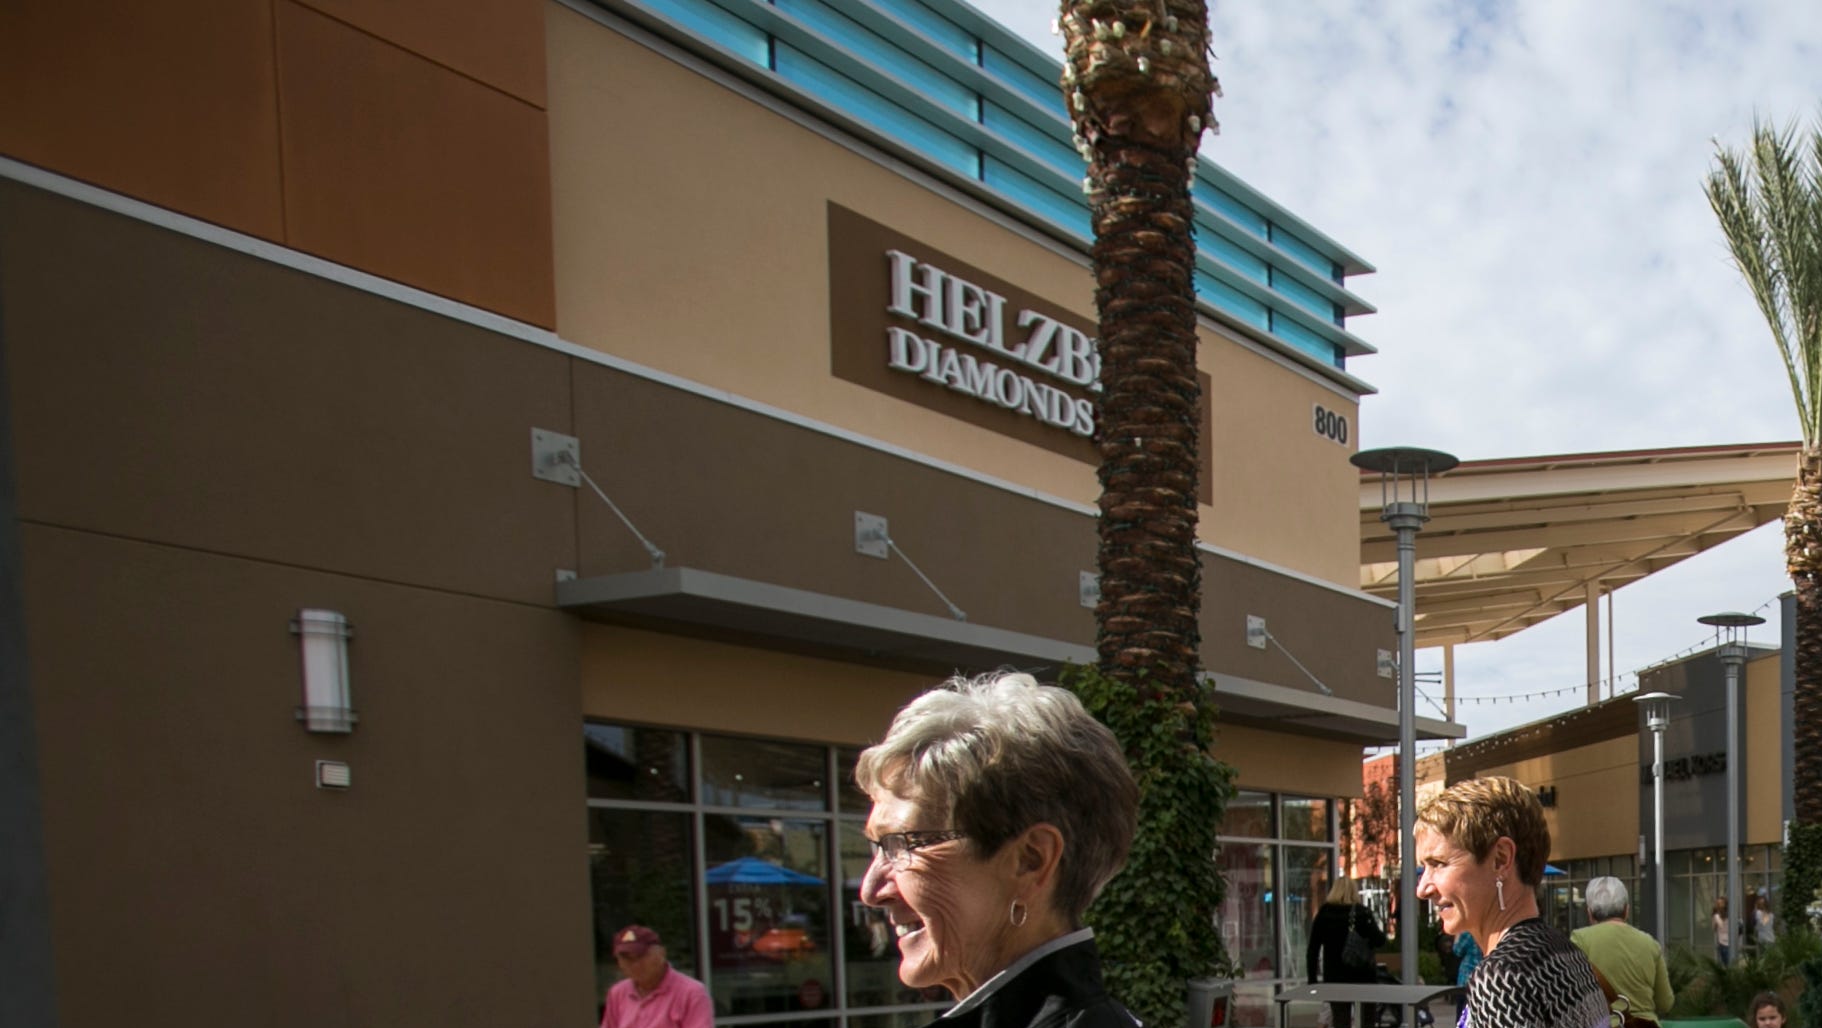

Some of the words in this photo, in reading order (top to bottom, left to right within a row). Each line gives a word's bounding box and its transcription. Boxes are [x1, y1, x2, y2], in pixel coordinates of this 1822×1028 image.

[886, 249, 1102, 392] HELZB
[887, 327, 1094, 436] DIAMONDS
[1315, 405, 1348, 445] 800
